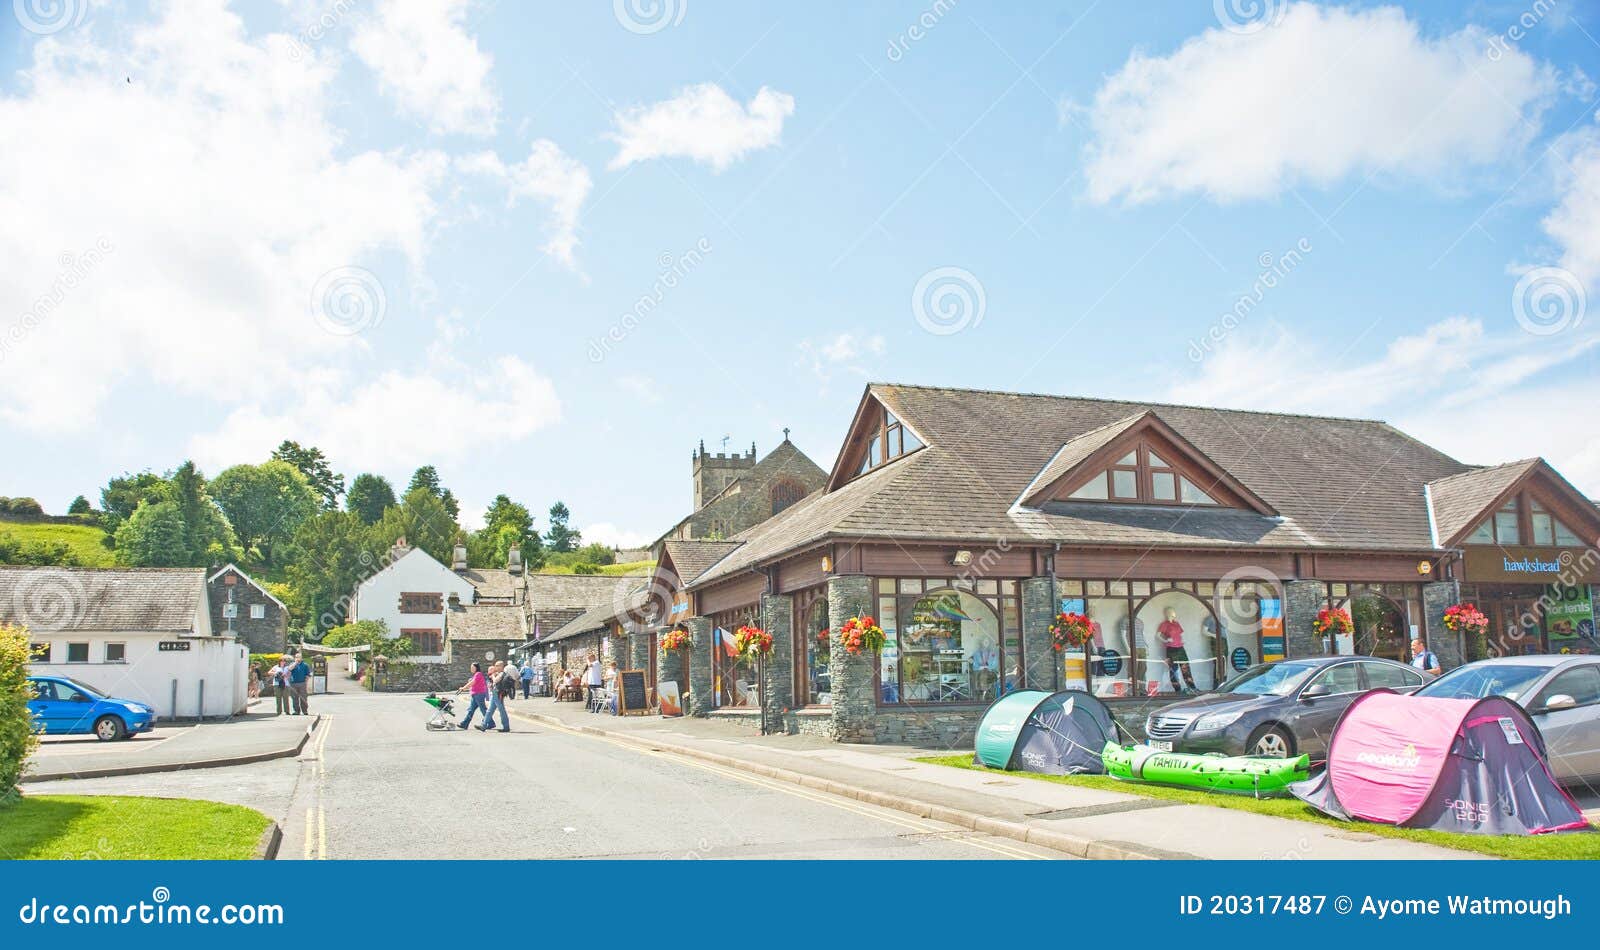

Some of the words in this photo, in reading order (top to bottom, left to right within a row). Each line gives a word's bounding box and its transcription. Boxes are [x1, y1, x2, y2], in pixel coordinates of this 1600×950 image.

[1503, 557, 1560, 572] hawkshead
[1153, 757, 1182, 768] TAHITI
[1445, 798, 1489, 813] SONIC
[1456, 811, 1488, 823] 200
